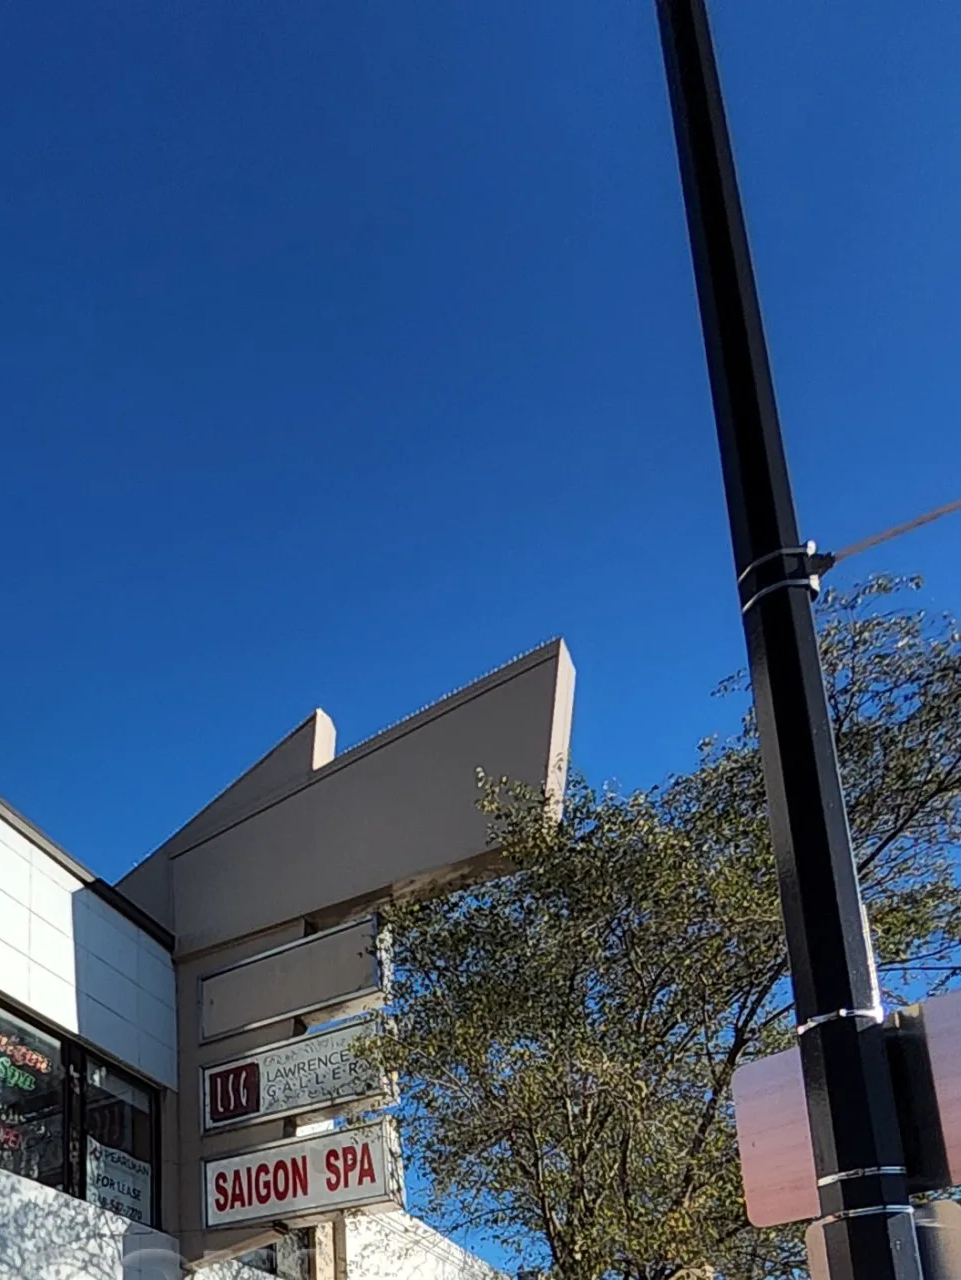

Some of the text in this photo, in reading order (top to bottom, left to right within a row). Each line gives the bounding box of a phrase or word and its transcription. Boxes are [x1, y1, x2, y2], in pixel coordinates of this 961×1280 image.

[266, 1050, 350, 1083] LAWRENCE
[96, 1172, 142, 1202] FOR LEASE
[214, 1142, 376, 1212] SAIGON SPA
